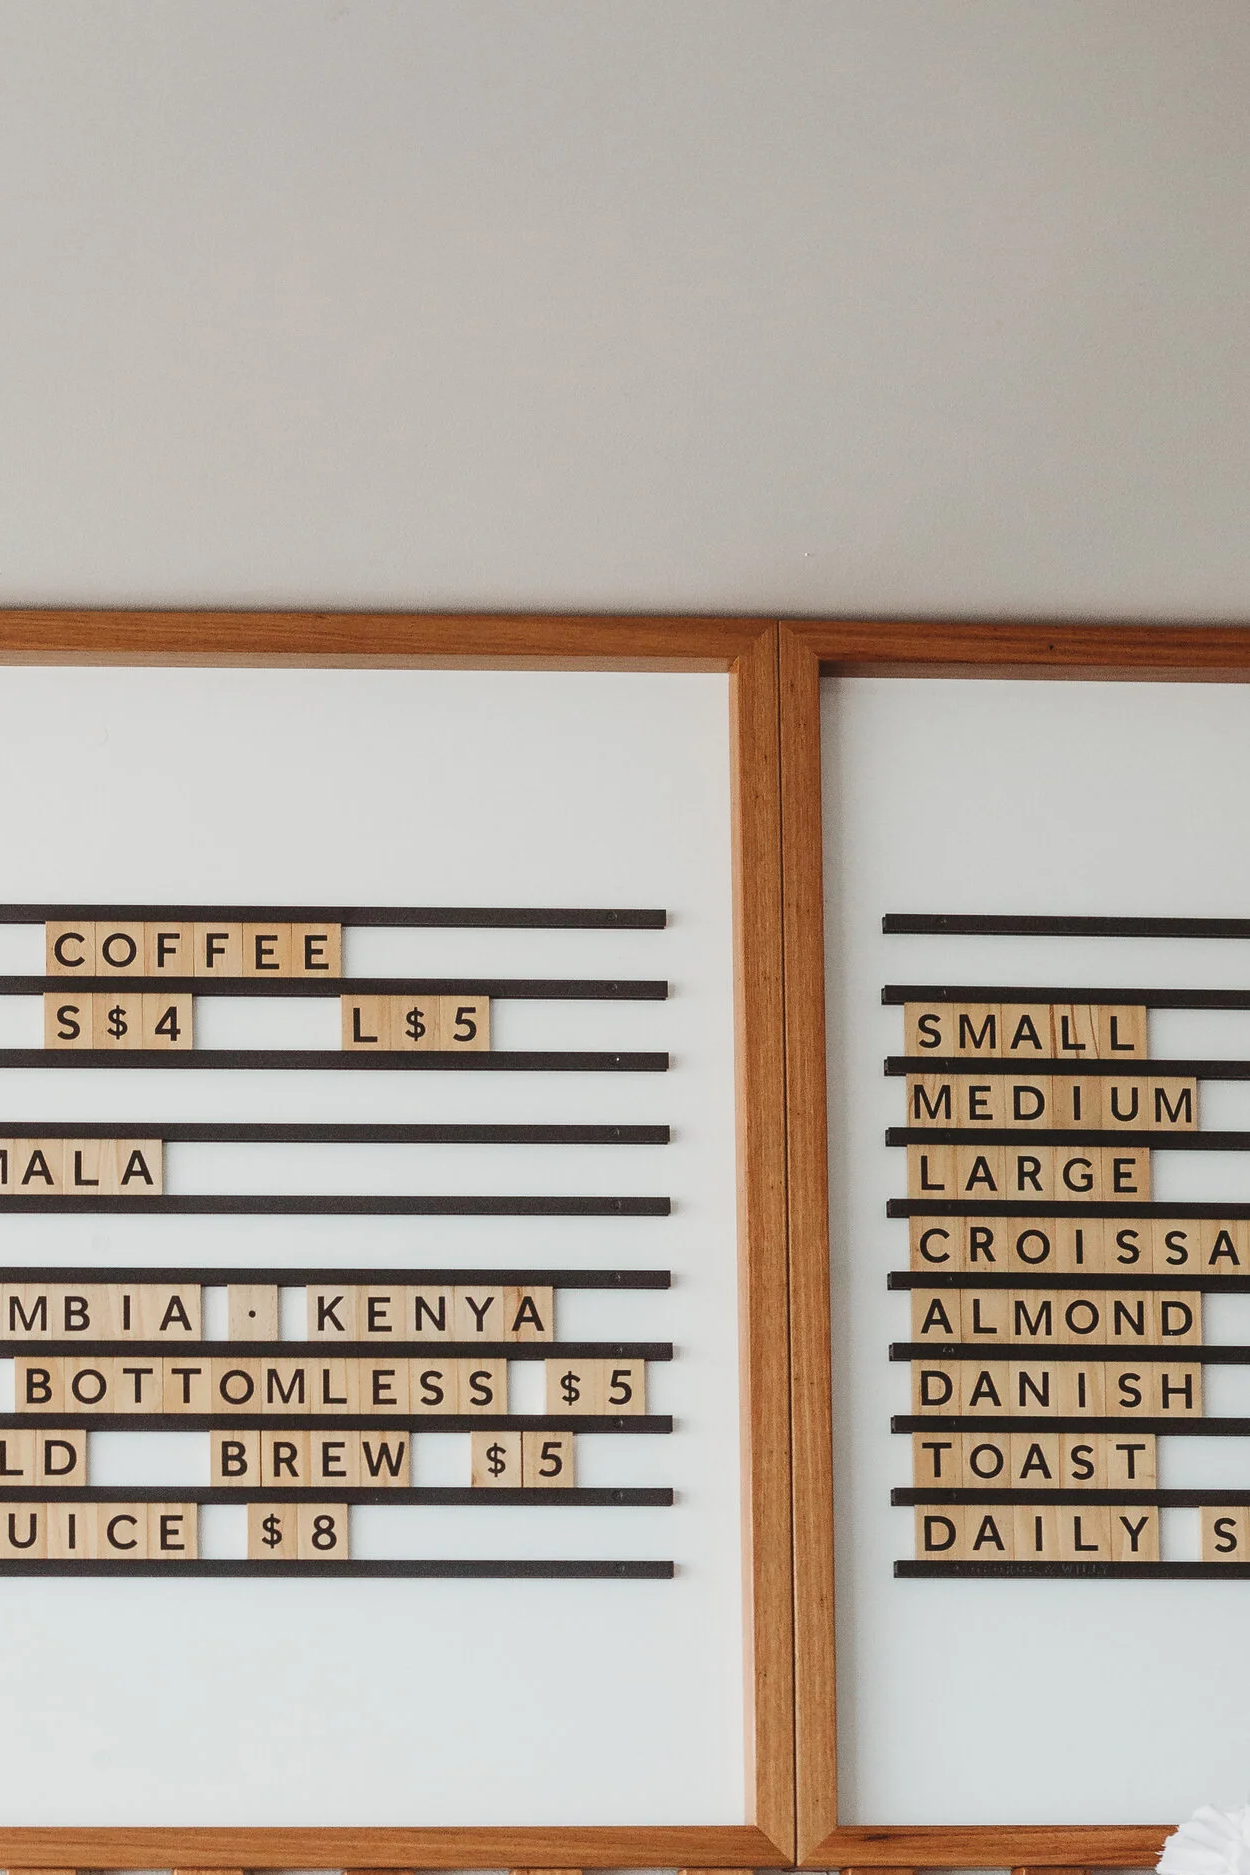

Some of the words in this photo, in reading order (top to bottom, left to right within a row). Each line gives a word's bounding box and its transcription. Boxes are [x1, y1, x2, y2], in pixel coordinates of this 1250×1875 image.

[54, 932, 329, 970] COFFEE
[917, 1013, 1135, 1051] SMALL
[913, 1084, 1192, 1123] MEDIUM
[920, 1155, 1138, 1194] LARGE
[919, 1226, 1241, 1266] CROISSA
[317, 1295, 545, 1333] KENYA
[920, 1298, 1193, 1337] ALMOND
[26, 1367, 493, 1406] BOTTOMLESS
[560, 1369, 632, 1406] $5
[920, 1370, 1193, 1410] DANISH
[221, 1440, 405, 1478] BREW
[486, 1441, 563, 1478] $5
[921, 1442, 1146, 1481] TOAST
[261, 1513, 337, 1551] $8
[923, 1515, 1149, 1552] DAILY
